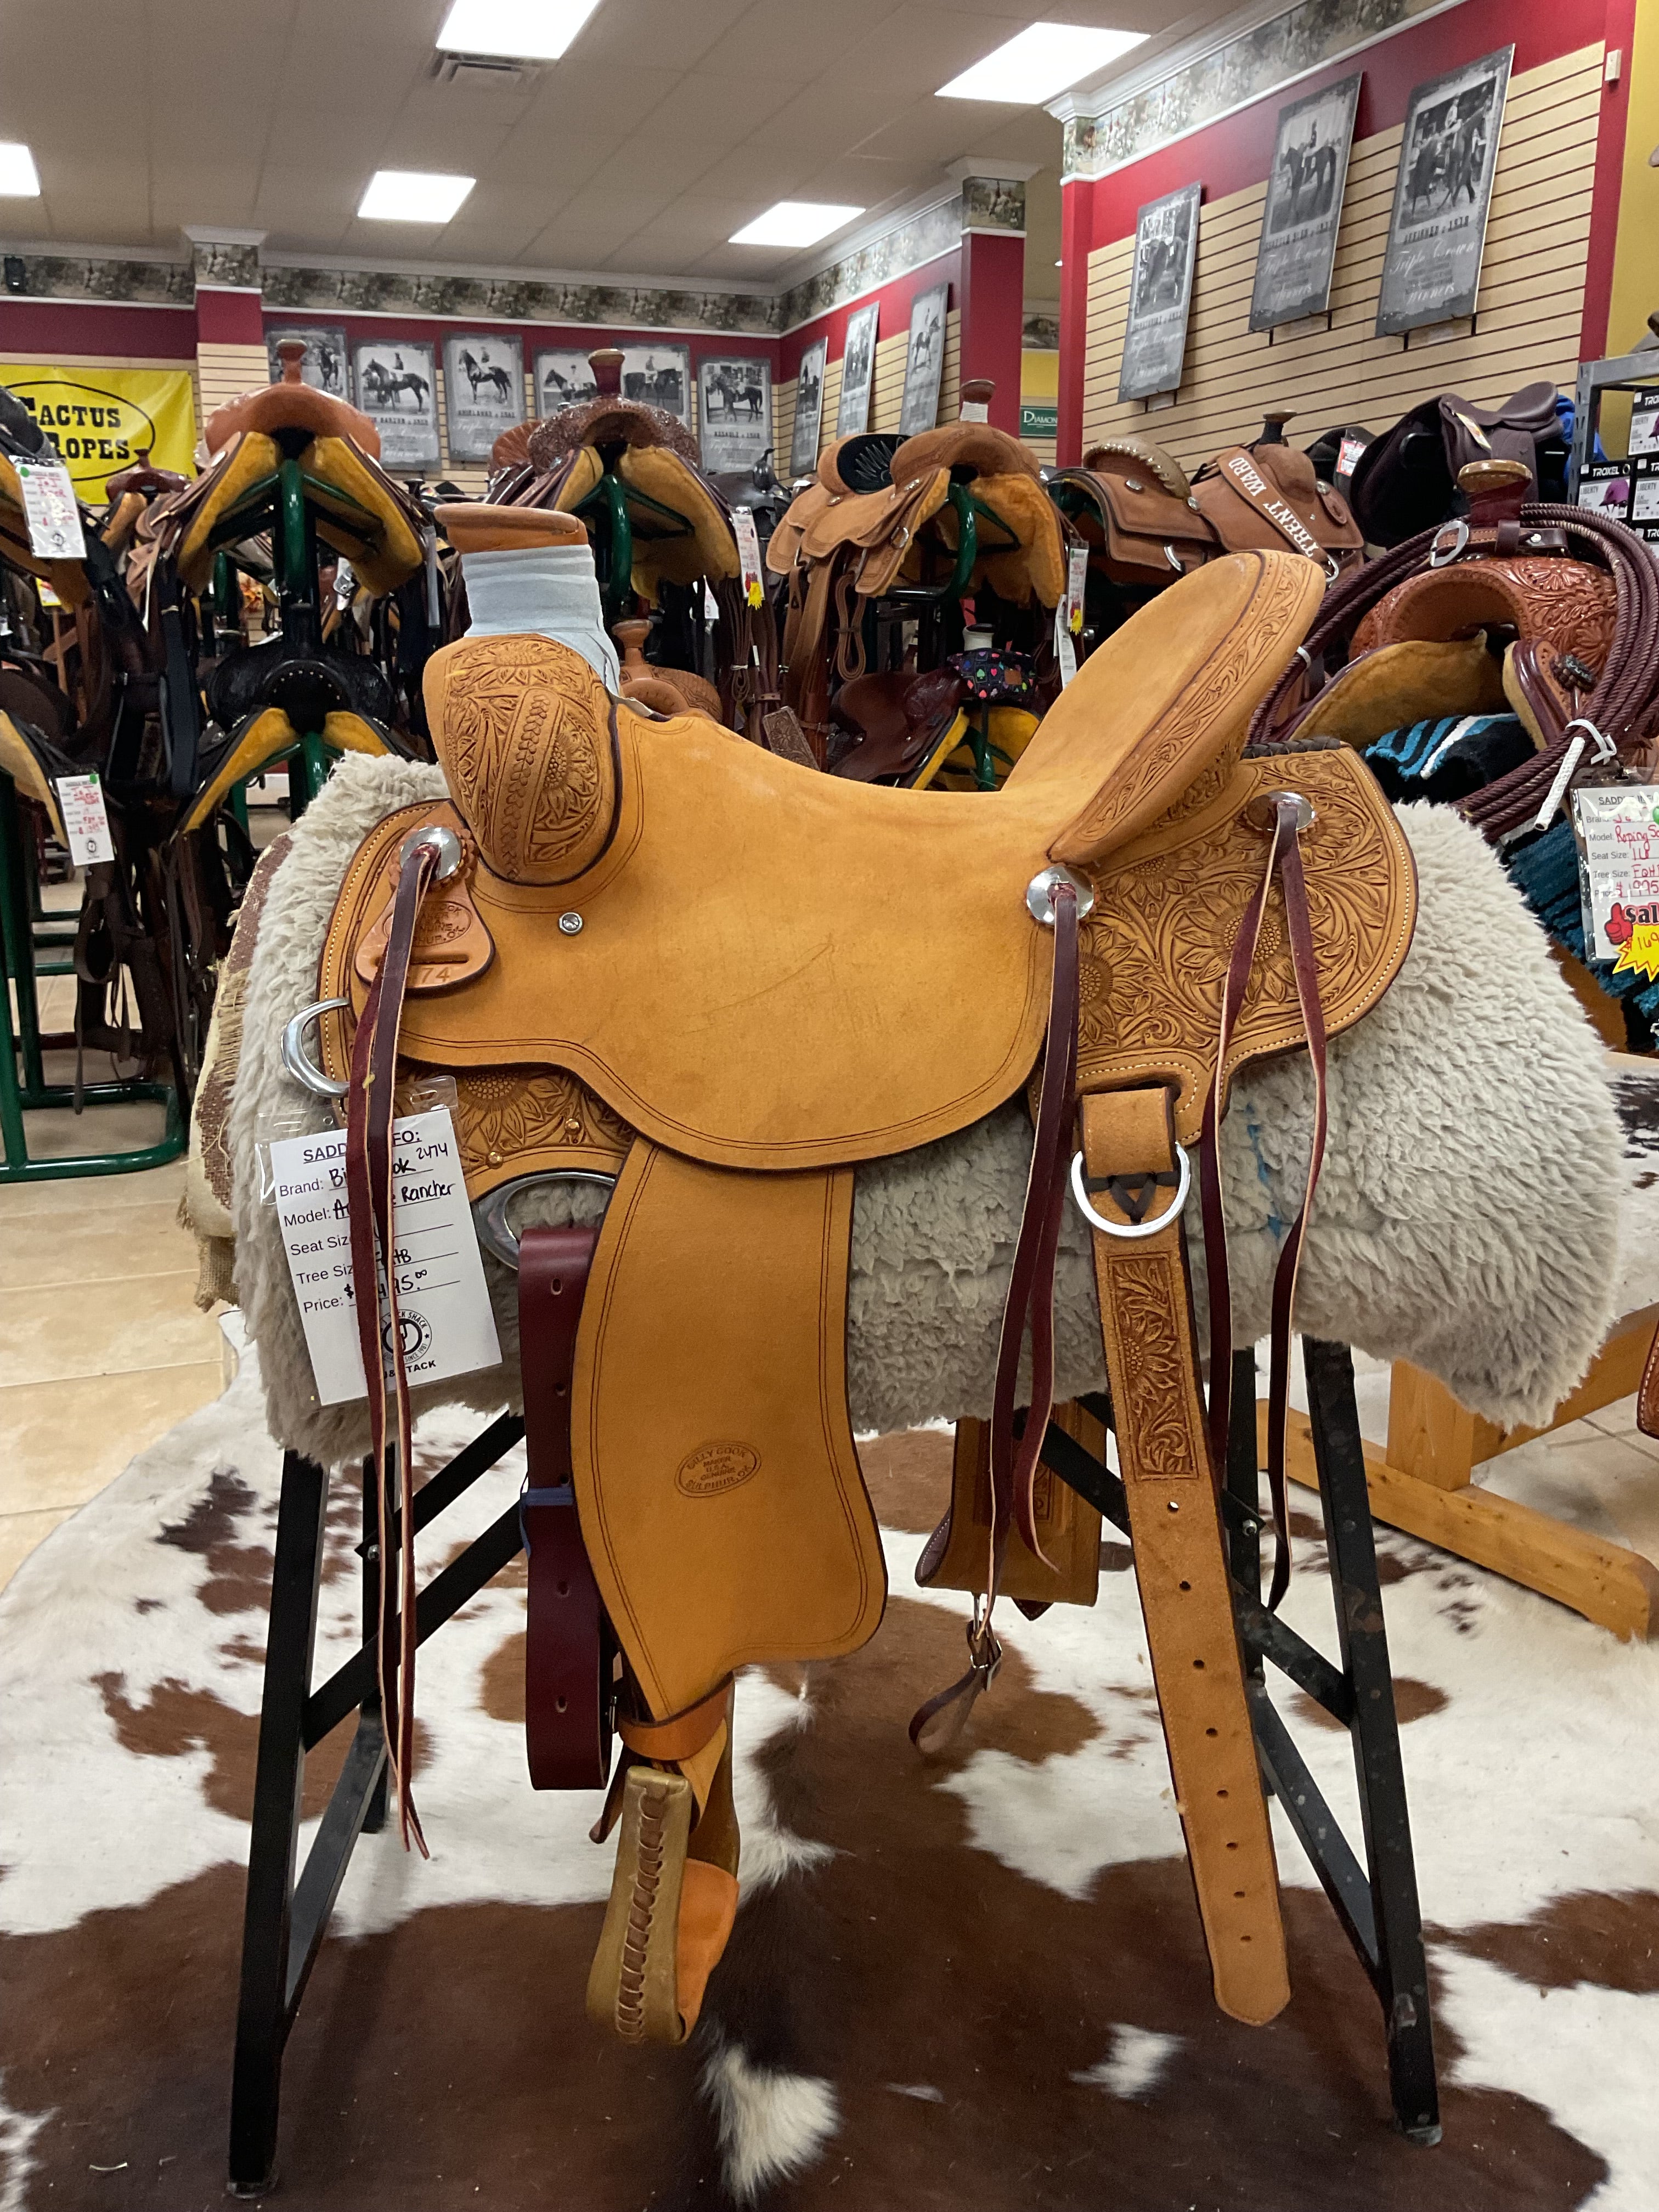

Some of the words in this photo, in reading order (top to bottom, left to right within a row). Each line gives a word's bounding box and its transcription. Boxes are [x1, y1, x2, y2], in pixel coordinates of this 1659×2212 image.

[1023, 410, 1058, 424] DIAMON
[1228, 457, 1267, 496] WARD
[1593, 466, 1620, 477] TROXEL
[1262, 500, 1319, 557] TRENT
[303, 1143, 347, 1162] SADD
[280, 1178, 324, 1197] Brand:
[416, 1143, 448, 1160] 2474
[284, 1208, 331, 1227] Model:
[402, 1180, 456, 1203] Rancher
[291, 1240, 324, 1256] Seat
[296, 1270, 329, 1284] Tree
[304, 1296, 344, 1313] Price:
[408, 1312, 428, 1329] SHACK
[405, 1360, 437, 1373] TACK
